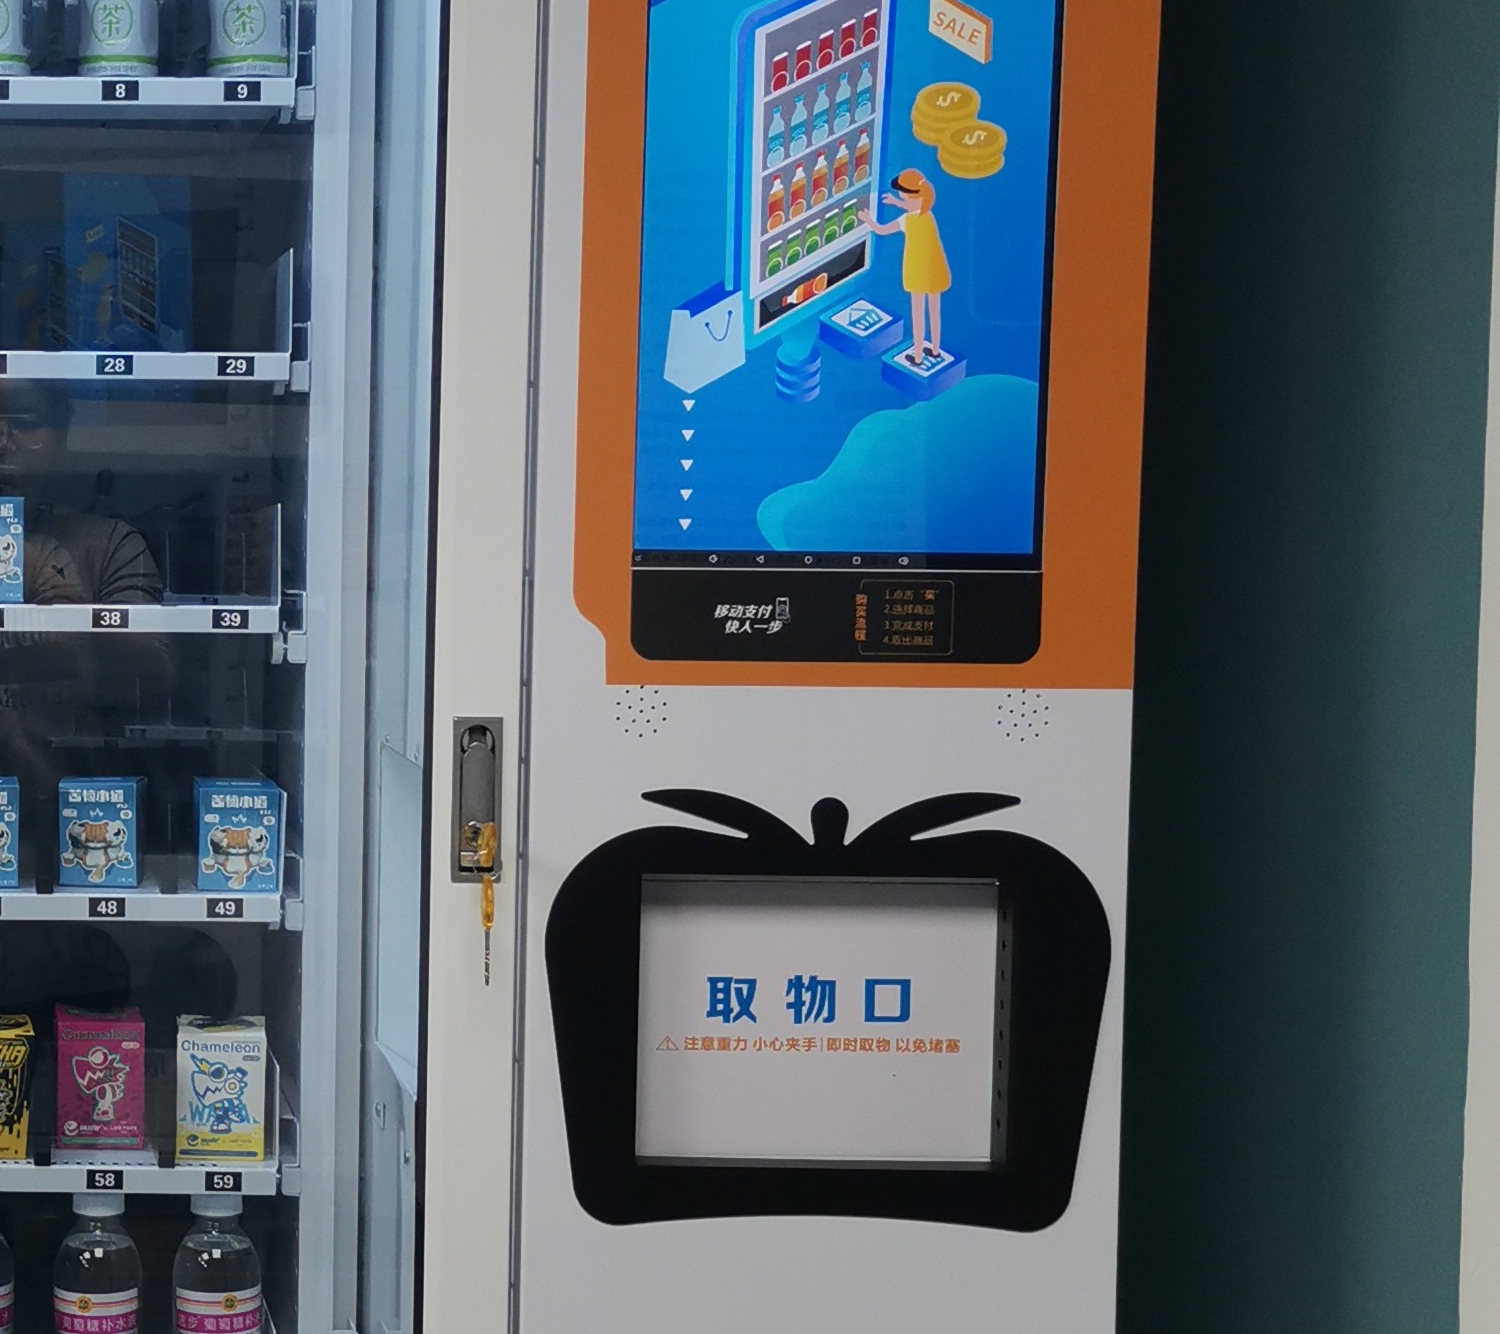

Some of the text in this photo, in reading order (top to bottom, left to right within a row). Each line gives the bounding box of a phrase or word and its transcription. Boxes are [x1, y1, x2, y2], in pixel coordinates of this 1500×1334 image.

[97, 3, 127, 38] 茶
[230, 3, 260, 36] 茶
[932, 10, 982, 46] SALE
[115, 83, 126, 99] 8
[237, 83, 248, 99] 9
[103, 357, 126, 373] 28
[225, 358, 247, 374] 29
[99, 611, 121, 626] 38
[220, 611, 241, 627] 39
[713, 603, 774, 620] 移动支付
[724, 619, 783, 635] 快人一步
[96, 900, 118, 915] 48
[214, 900, 236, 916] 49
[705, 974, 912, 1025] 取物口
[180, 1039, 261, 1054] Chameleon
[683, 1035, 961, 1054] 注意重力 小心夹手 即时取物 以免堵塞
[94, 1172, 115, 1187] 58
[213, 1174, 234, 1189] 59
